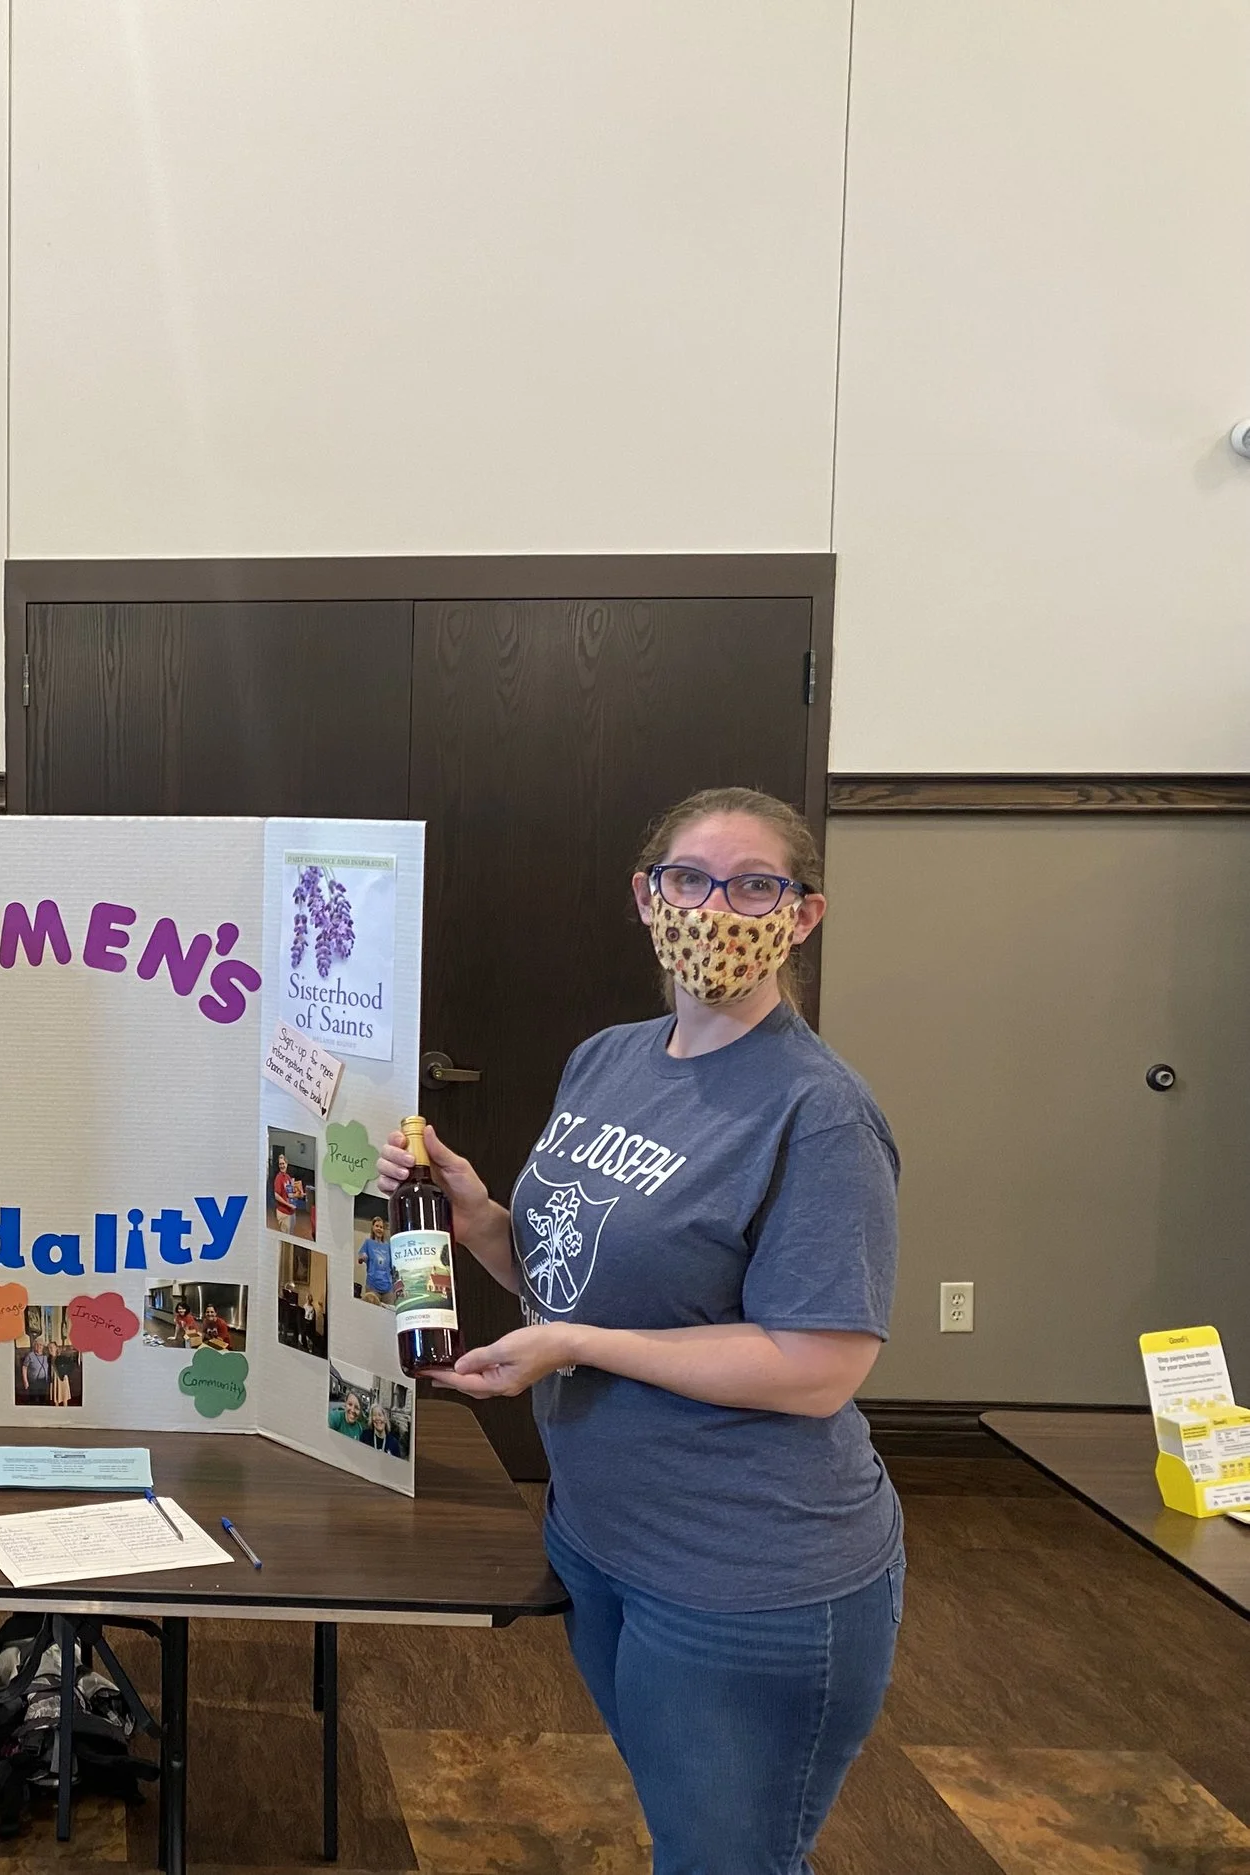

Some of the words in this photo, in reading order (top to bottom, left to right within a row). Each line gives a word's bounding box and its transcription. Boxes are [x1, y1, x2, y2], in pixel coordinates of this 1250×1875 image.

[288, 972, 383, 1010] Sisterhood
[296, 1003, 317, 1029] of
[319, 1006, 373, 1038] Saints
[272, 1045, 304, 1076] information
[316, 1080, 321, 1089] a
[310, 1050, 318, 1065] for
[320, 1064, 334, 1080] more
[285, 1073, 292, 1084] at
[294, 1080, 298, 1088] a
[299, 1079, 309, 1097] free
[329, 1142, 368, 1169] Prayer
[535, 1111, 587, 1159] ST.
[571, 1123, 687, 1197] JOSEPH
[404, 1247, 436, 1257] JAMES
[72, 1305, 123, 1337] Inspire
[182, 1372, 245, 1400] Community
